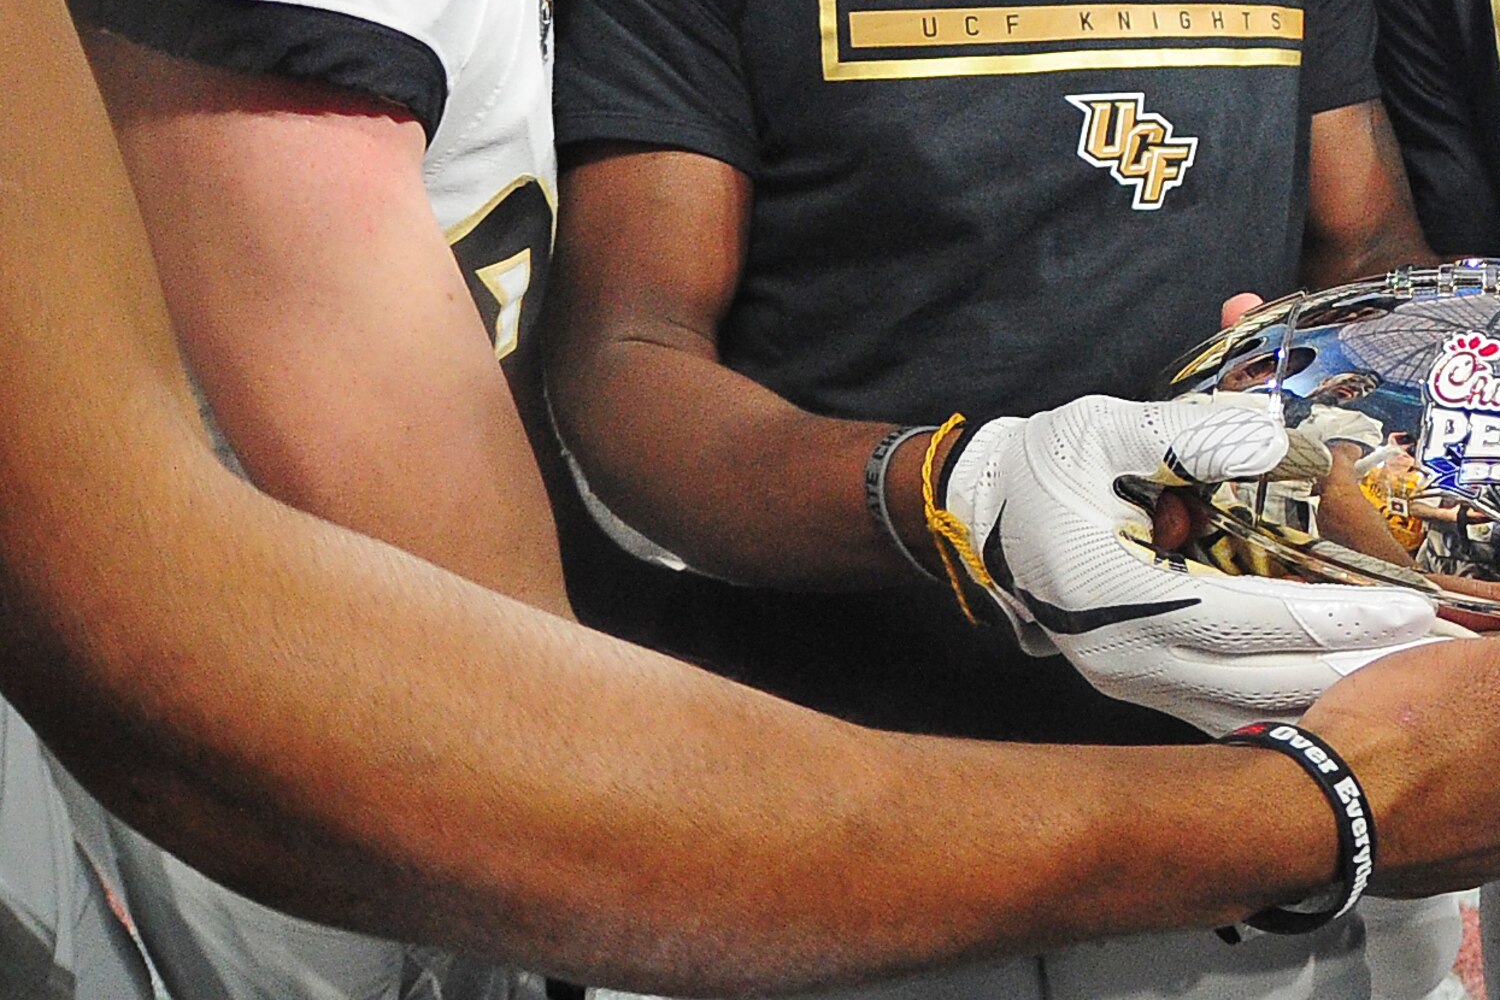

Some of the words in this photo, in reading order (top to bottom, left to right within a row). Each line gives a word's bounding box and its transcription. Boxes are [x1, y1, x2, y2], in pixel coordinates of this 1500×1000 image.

[921, 13, 1020, 38] UCF
[1079, 11, 1282, 32] KNIGHTS
[1064, 92, 1199, 211] UCF
[1268, 725, 1340, 775] Over
